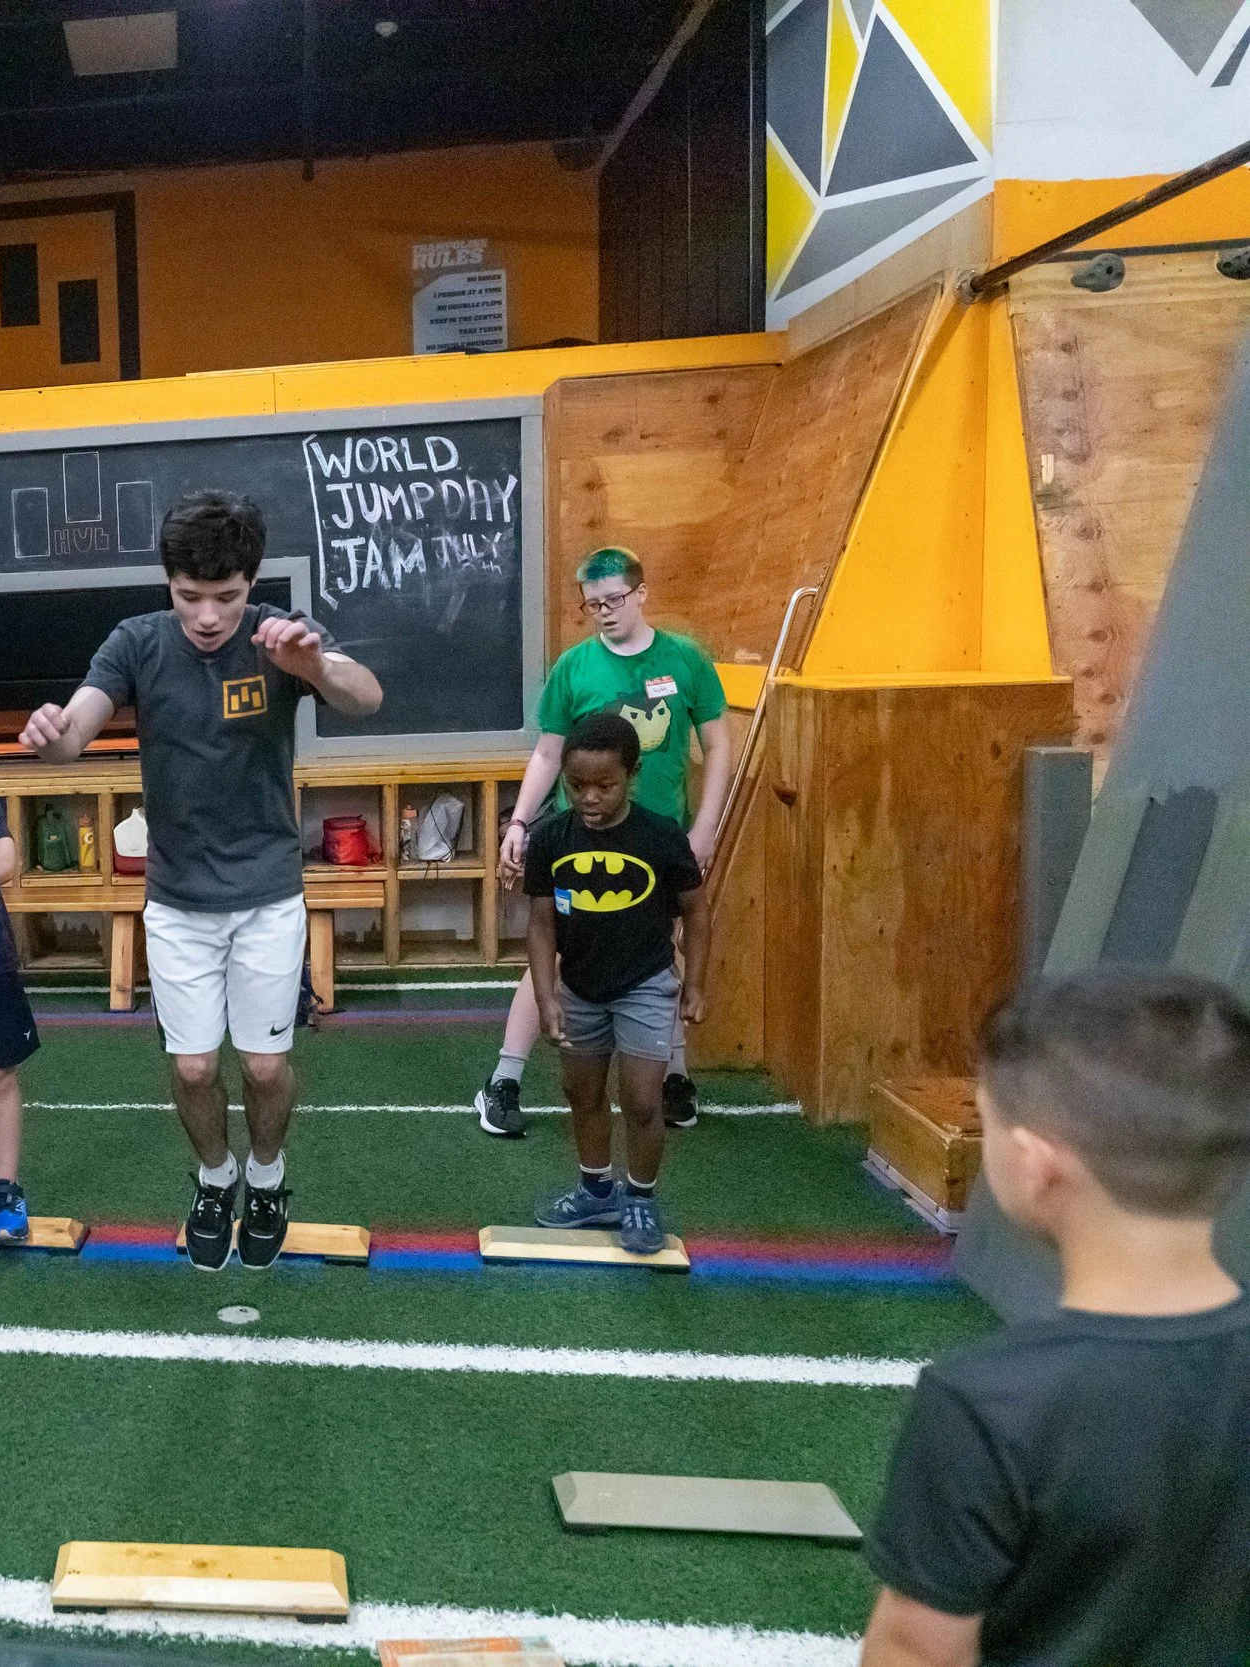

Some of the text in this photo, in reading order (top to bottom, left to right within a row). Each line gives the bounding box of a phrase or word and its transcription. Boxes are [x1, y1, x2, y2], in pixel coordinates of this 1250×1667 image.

[413, 248, 484, 270] RULES
[310, 436, 460, 478] WORLD
[331, 536, 427, 594] JAM
